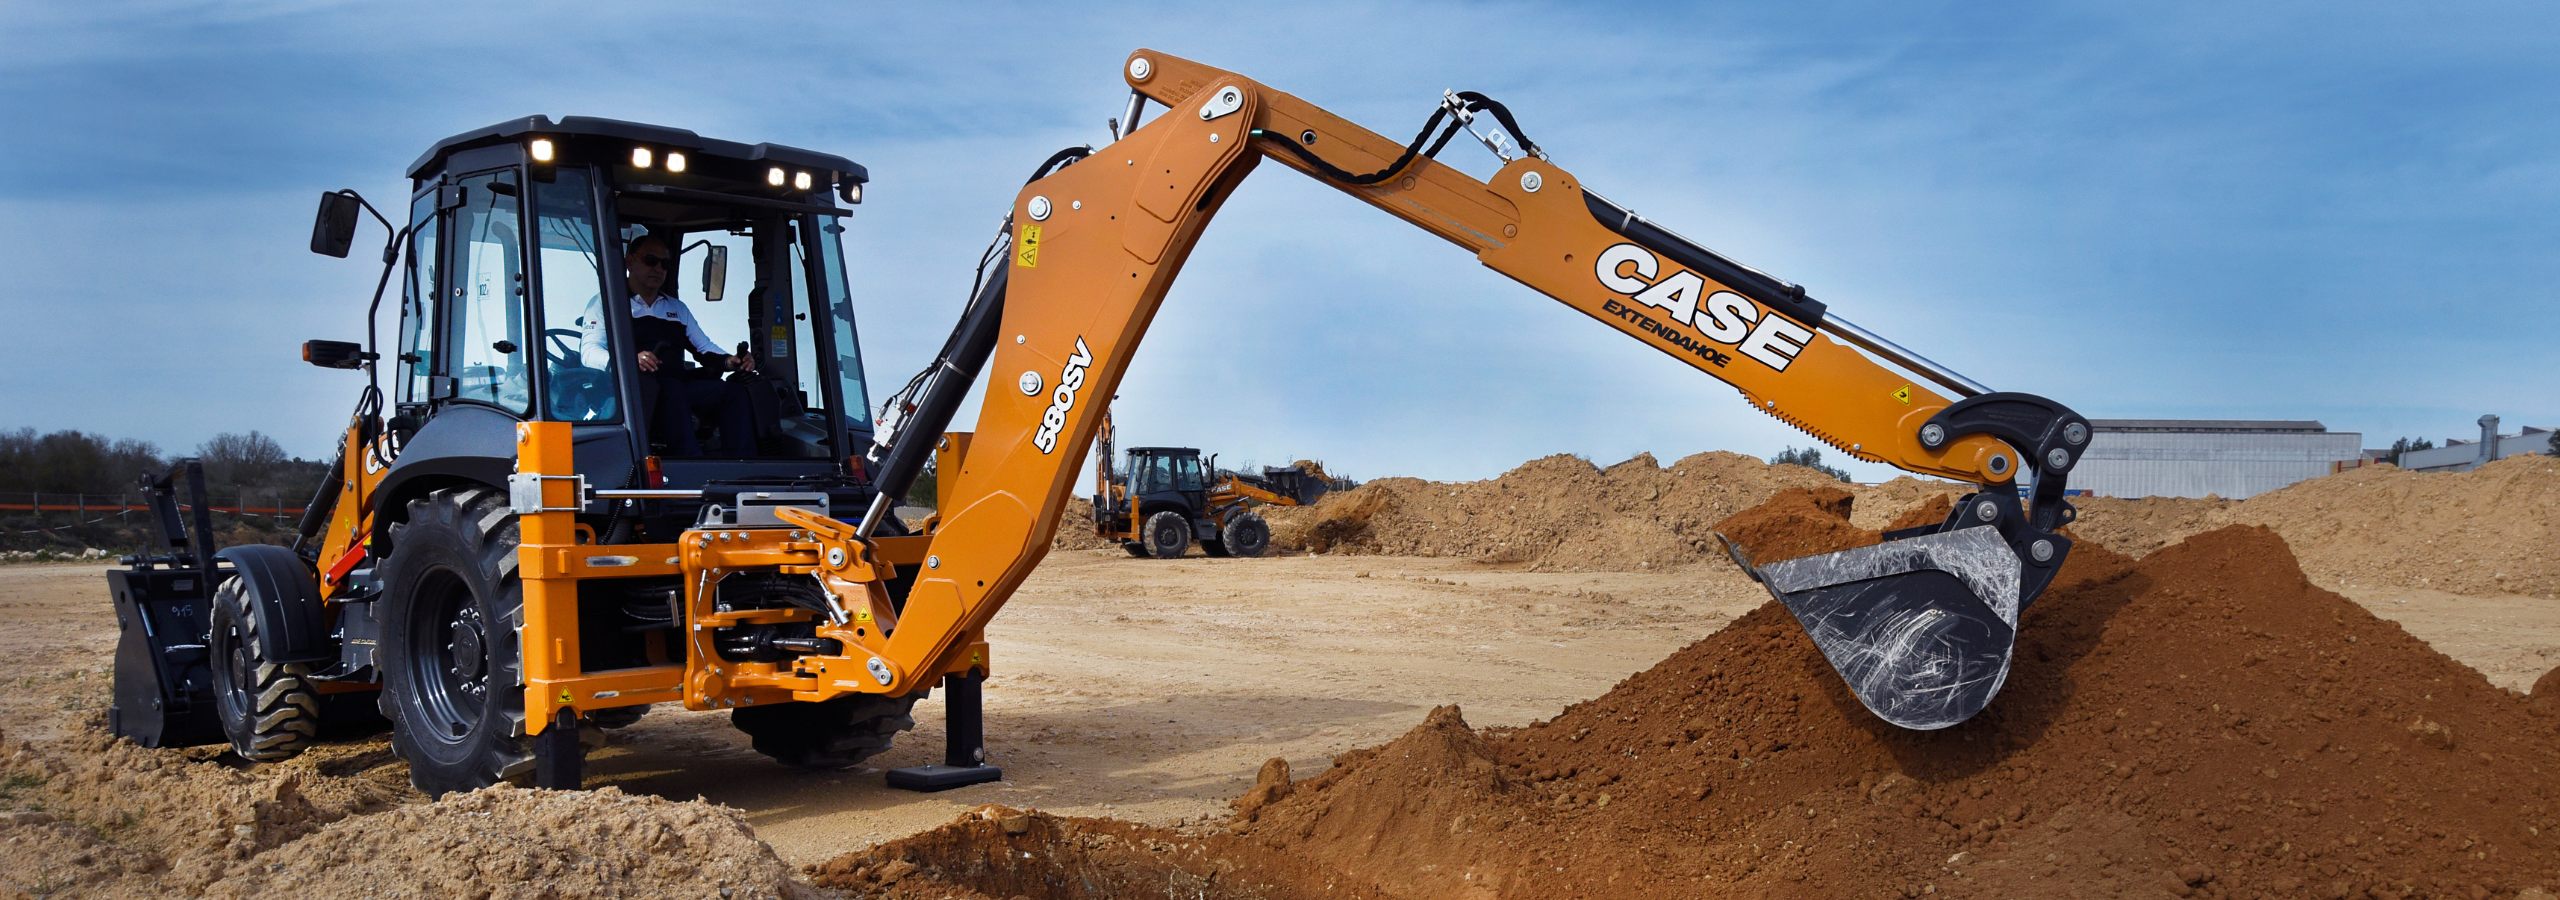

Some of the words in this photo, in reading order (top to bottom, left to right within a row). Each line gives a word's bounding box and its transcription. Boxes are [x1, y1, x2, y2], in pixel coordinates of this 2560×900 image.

[1595, 242, 1817, 374] CASE
[1602, 298, 1732, 369] EXTENDAHOE
[1032, 334, 1094, 455] 580SV
[171, 604, 193, 617] 915
